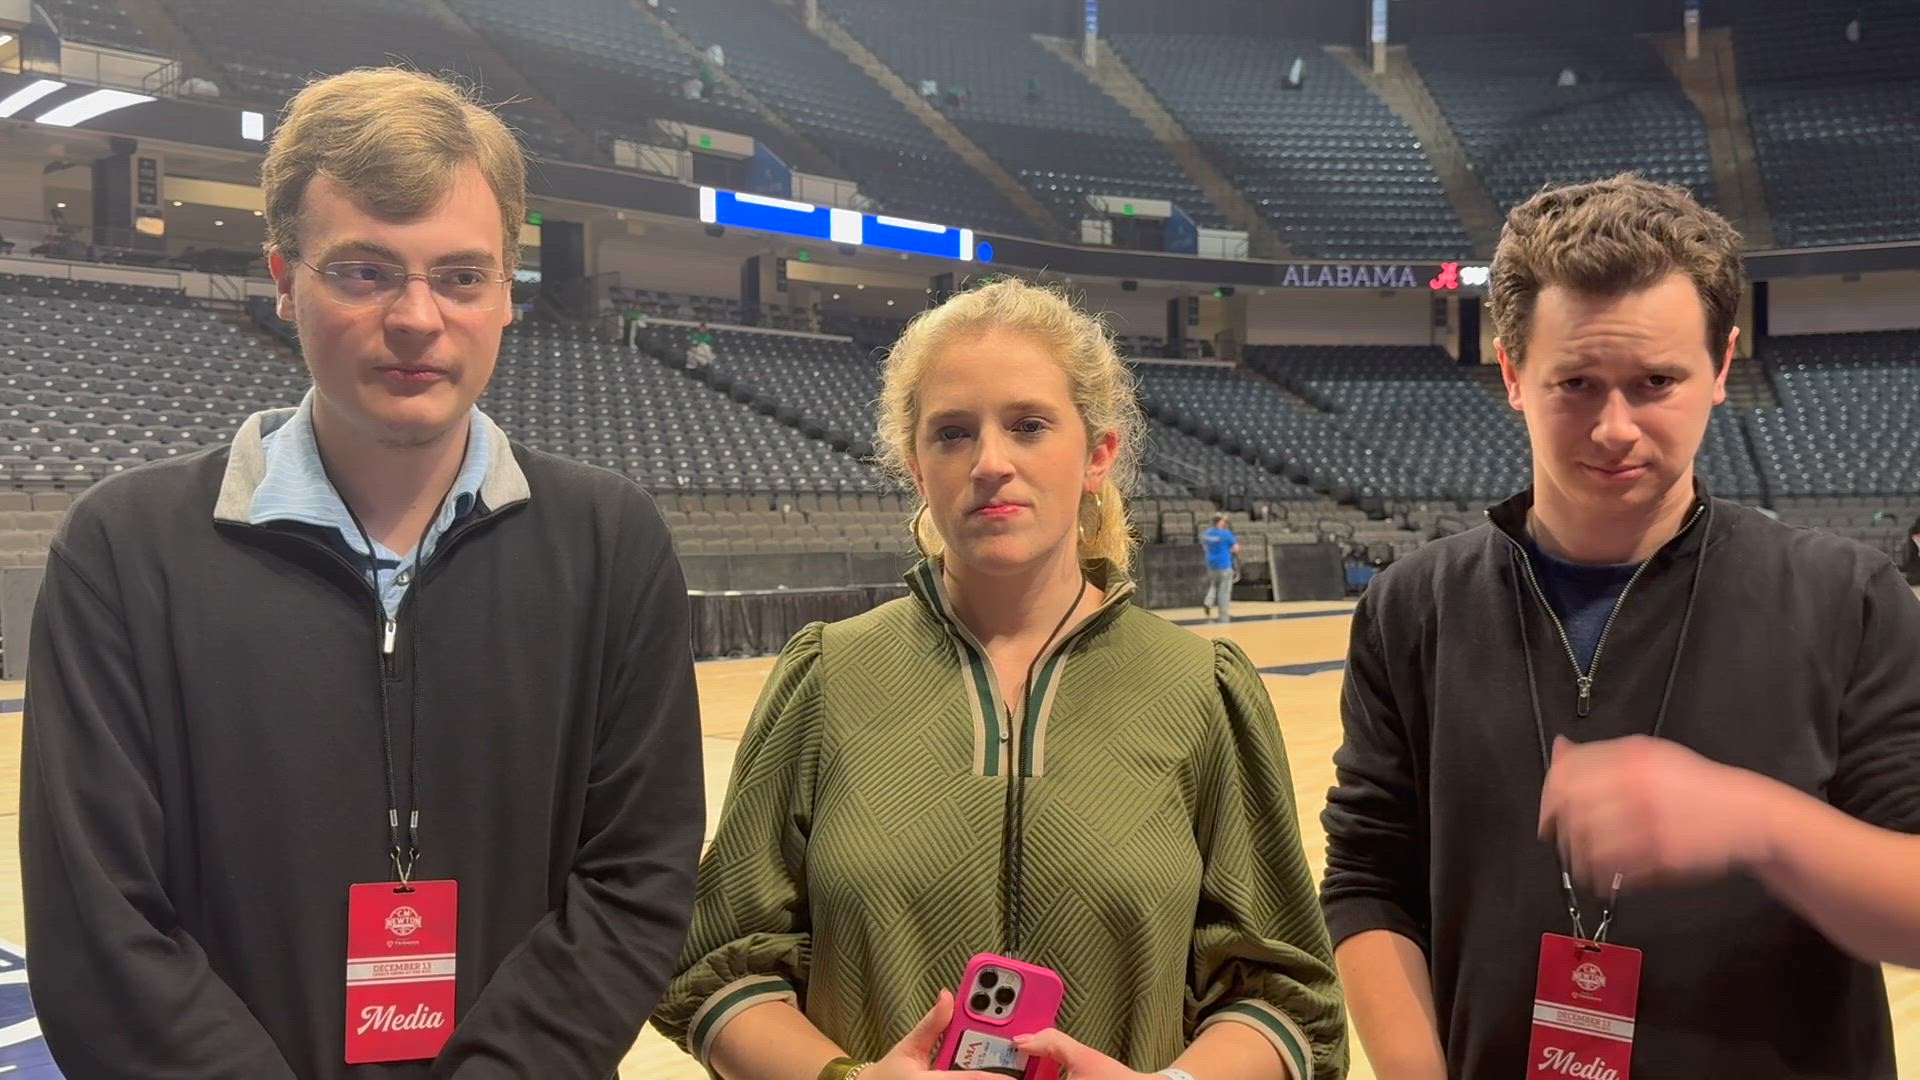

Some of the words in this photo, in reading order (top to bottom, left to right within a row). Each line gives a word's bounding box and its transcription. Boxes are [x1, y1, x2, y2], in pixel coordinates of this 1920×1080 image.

[1282, 264, 1417, 288] ALABAMA
[385, 916, 422, 929] NEWTON
[373, 962, 421, 973] DECEMBER
[422, 961, 432, 971] 13
[357, 1003, 445, 1035] Media
[1556, 1010, 1601, 1026] DECEMBER
[1538, 1046, 1619, 1080] Media
